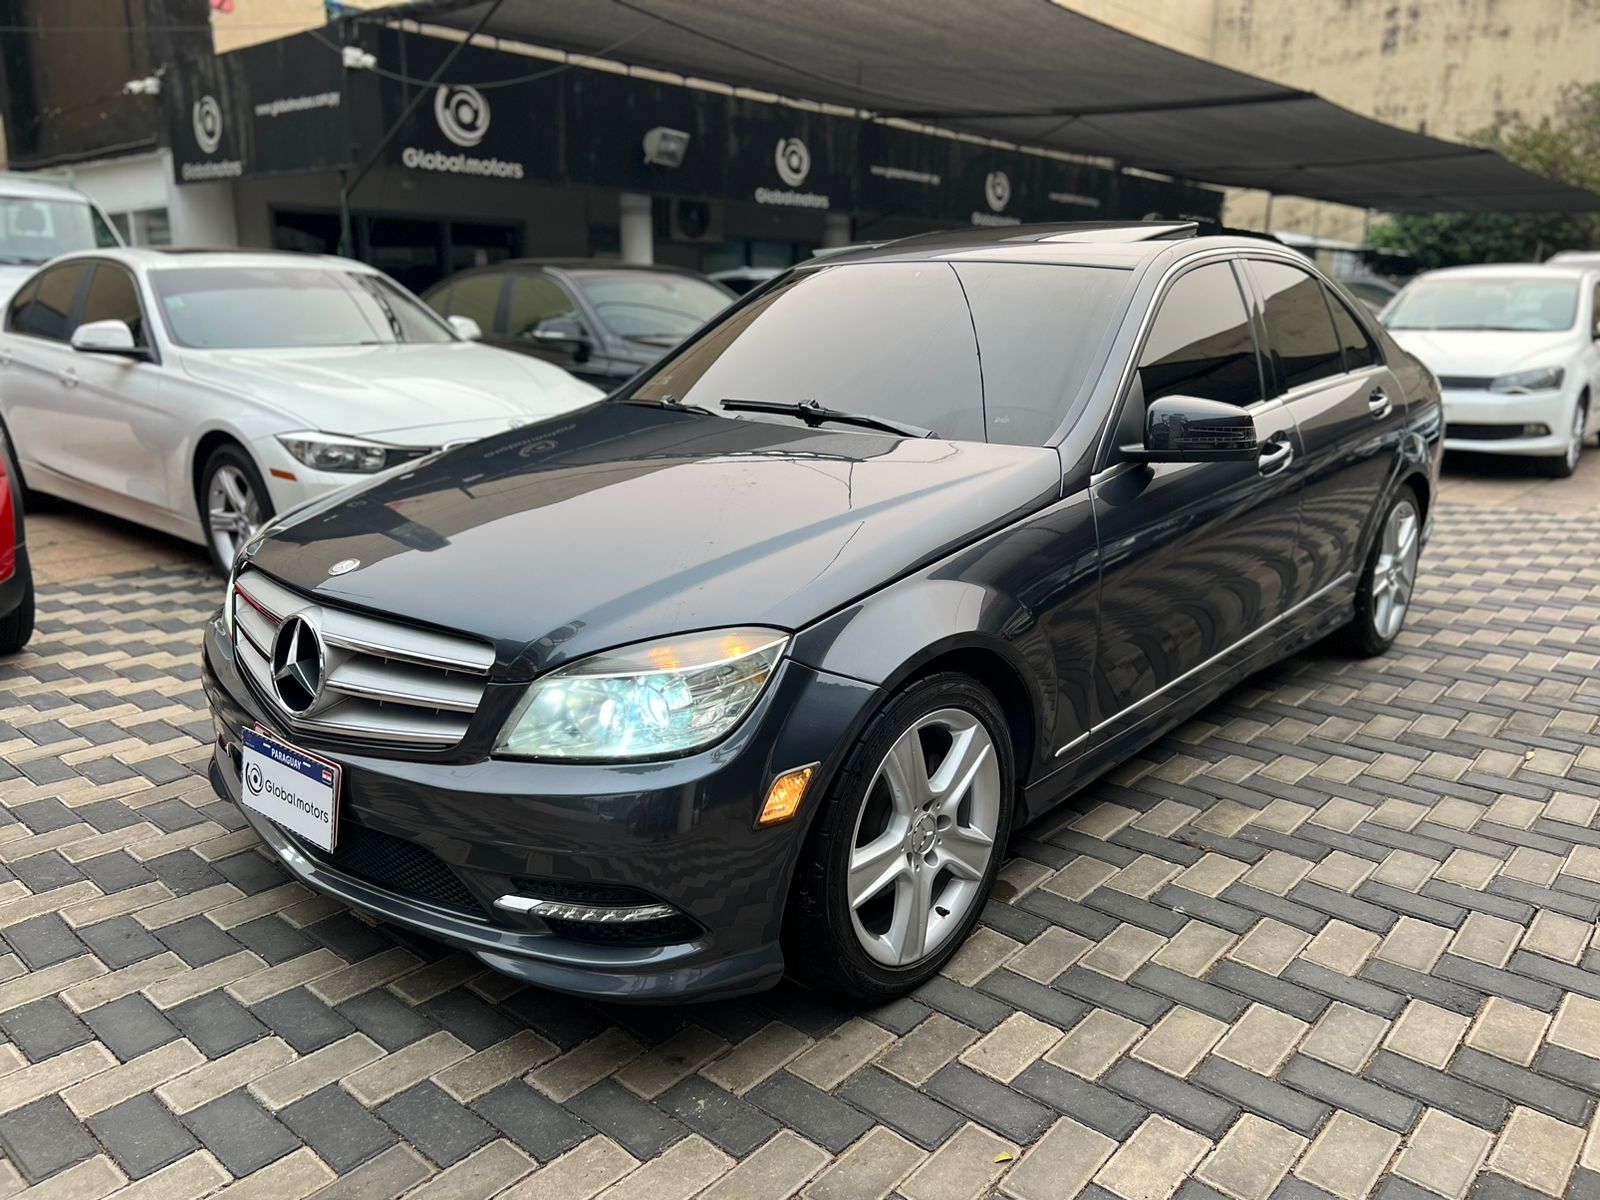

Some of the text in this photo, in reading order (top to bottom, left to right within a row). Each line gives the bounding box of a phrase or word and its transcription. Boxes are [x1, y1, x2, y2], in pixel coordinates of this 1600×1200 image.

[402, 147, 525, 179] Globalmotors
[271, 748, 302, 770] PARAGUAY
[265, 779, 329, 824] Globalmotors
